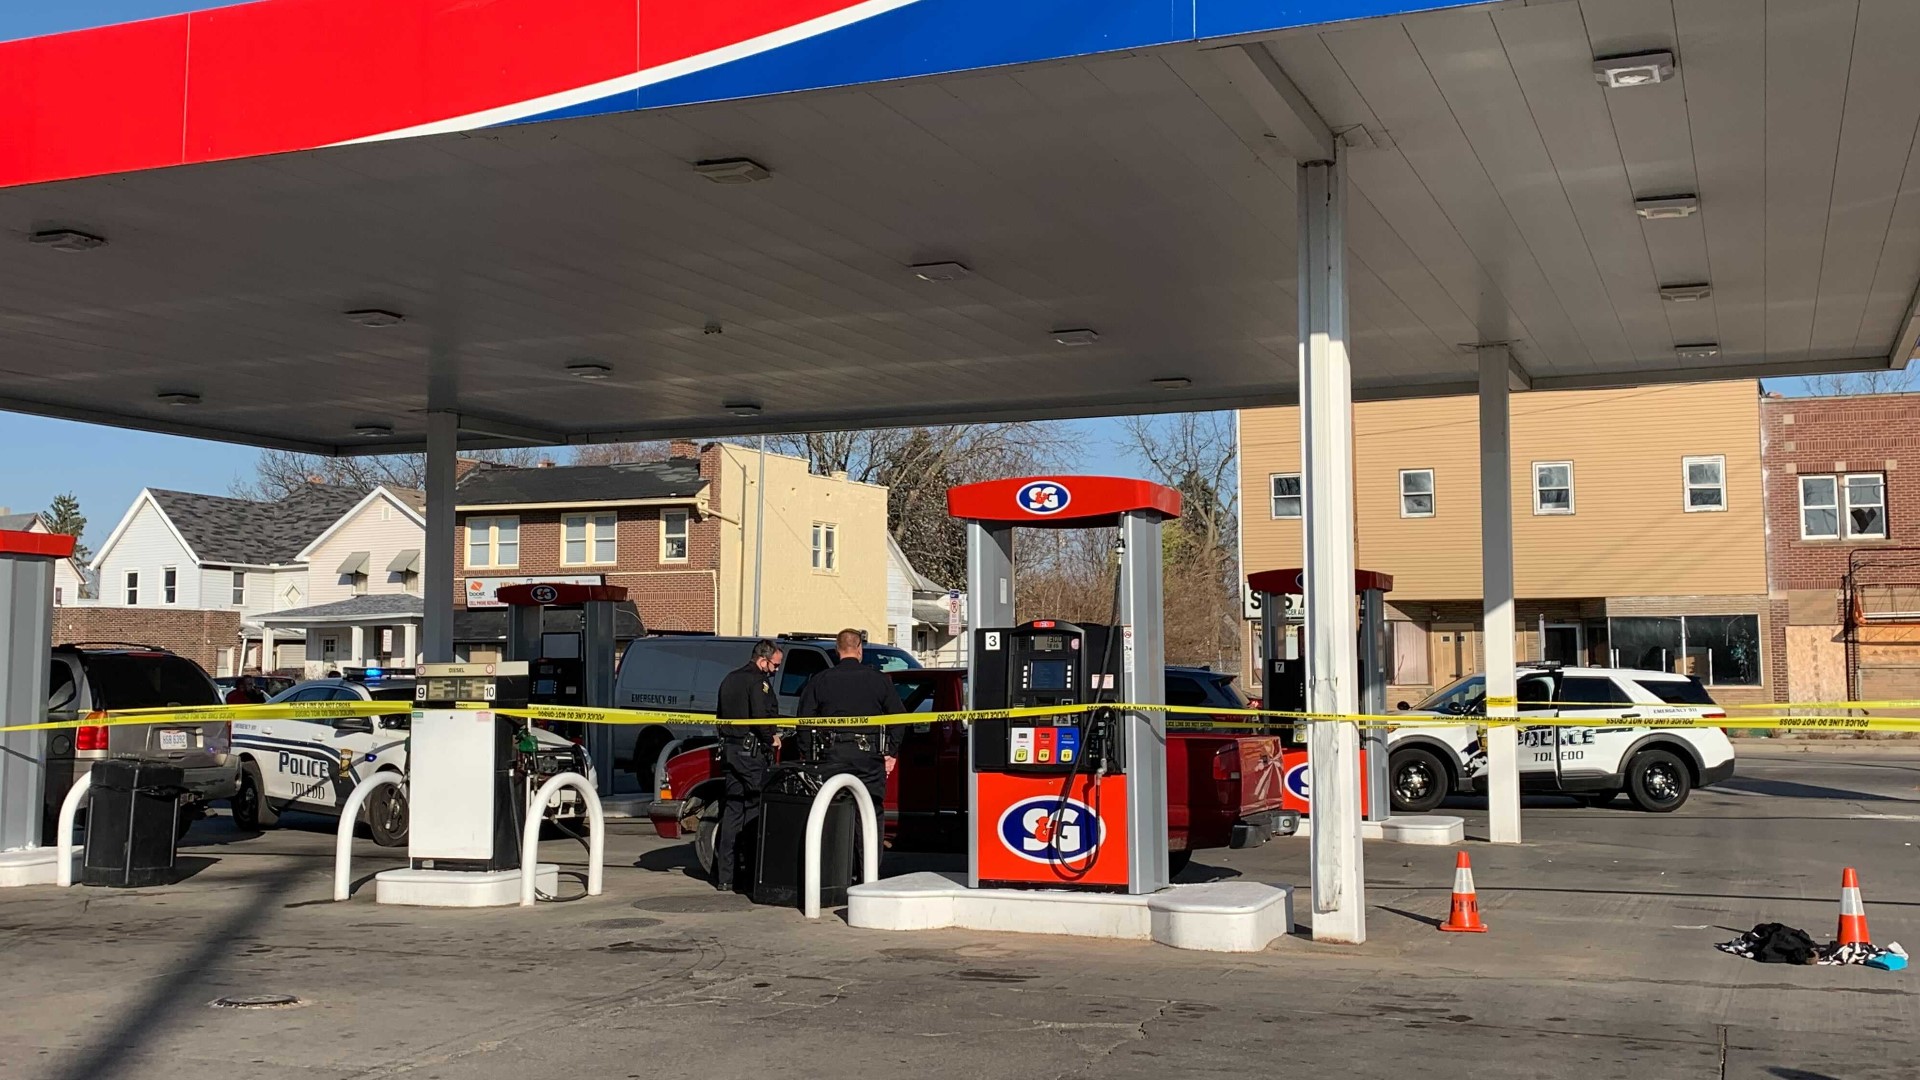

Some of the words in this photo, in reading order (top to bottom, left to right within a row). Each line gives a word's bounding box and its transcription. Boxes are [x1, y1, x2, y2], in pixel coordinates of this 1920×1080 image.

[988, 635, 997, 647] 3
[417, 687, 425, 698] 9
[485, 686, 495, 697] 10
[631, 693, 666, 705] EMERGENCY
[667, 696, 678, 705] 911
[976, 712, 990, 720] LINE
[989, 711, 1010, 720] POLICE
[1779, 718, 1800, 726] CROSS
[1802, 718, 1816, 726] NOT
[1817, 718, 1828, 727] DO
[1828, 719, 1844, 727] LINE
[1844, 719, 1870, 728] POLICE
[278, 750, 329, 778] POLICE
[290, 781, 325, 800] TOLEDO
[1022, 807, 1081, 852] S&G
